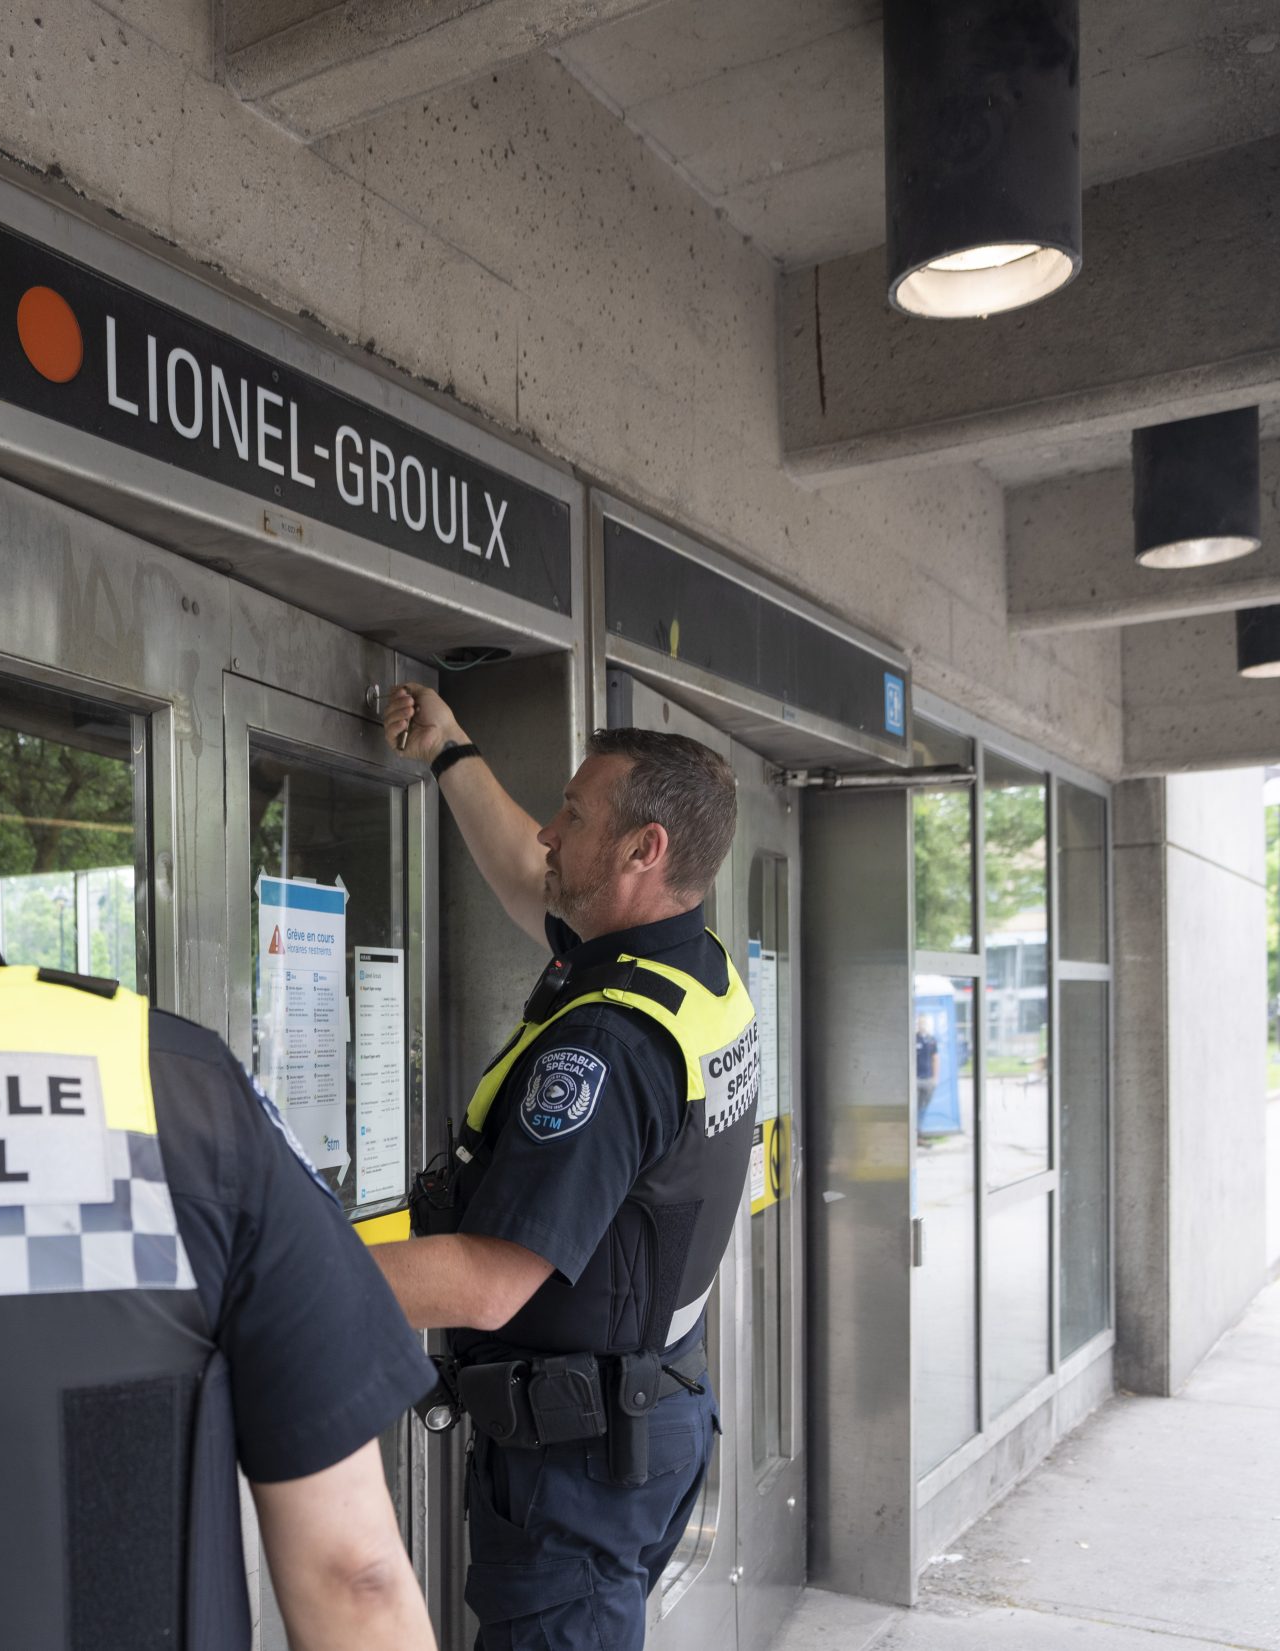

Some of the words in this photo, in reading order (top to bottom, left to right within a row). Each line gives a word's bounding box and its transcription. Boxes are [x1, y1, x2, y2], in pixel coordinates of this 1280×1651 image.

[105, 315, 511, 568] LIONEL-GROULX
[287, 928, 305, 941] Grève
[307, 932, 315, 941] en
[317, 933, 335, 943] cours
[542, 1052, 597, 1072] CONSTABLE
[546, 1061, 584, 1077] SPÉCIAL
[532, 1114, 562, 1130] STM
[327, 1139, 340, 1151] stm
